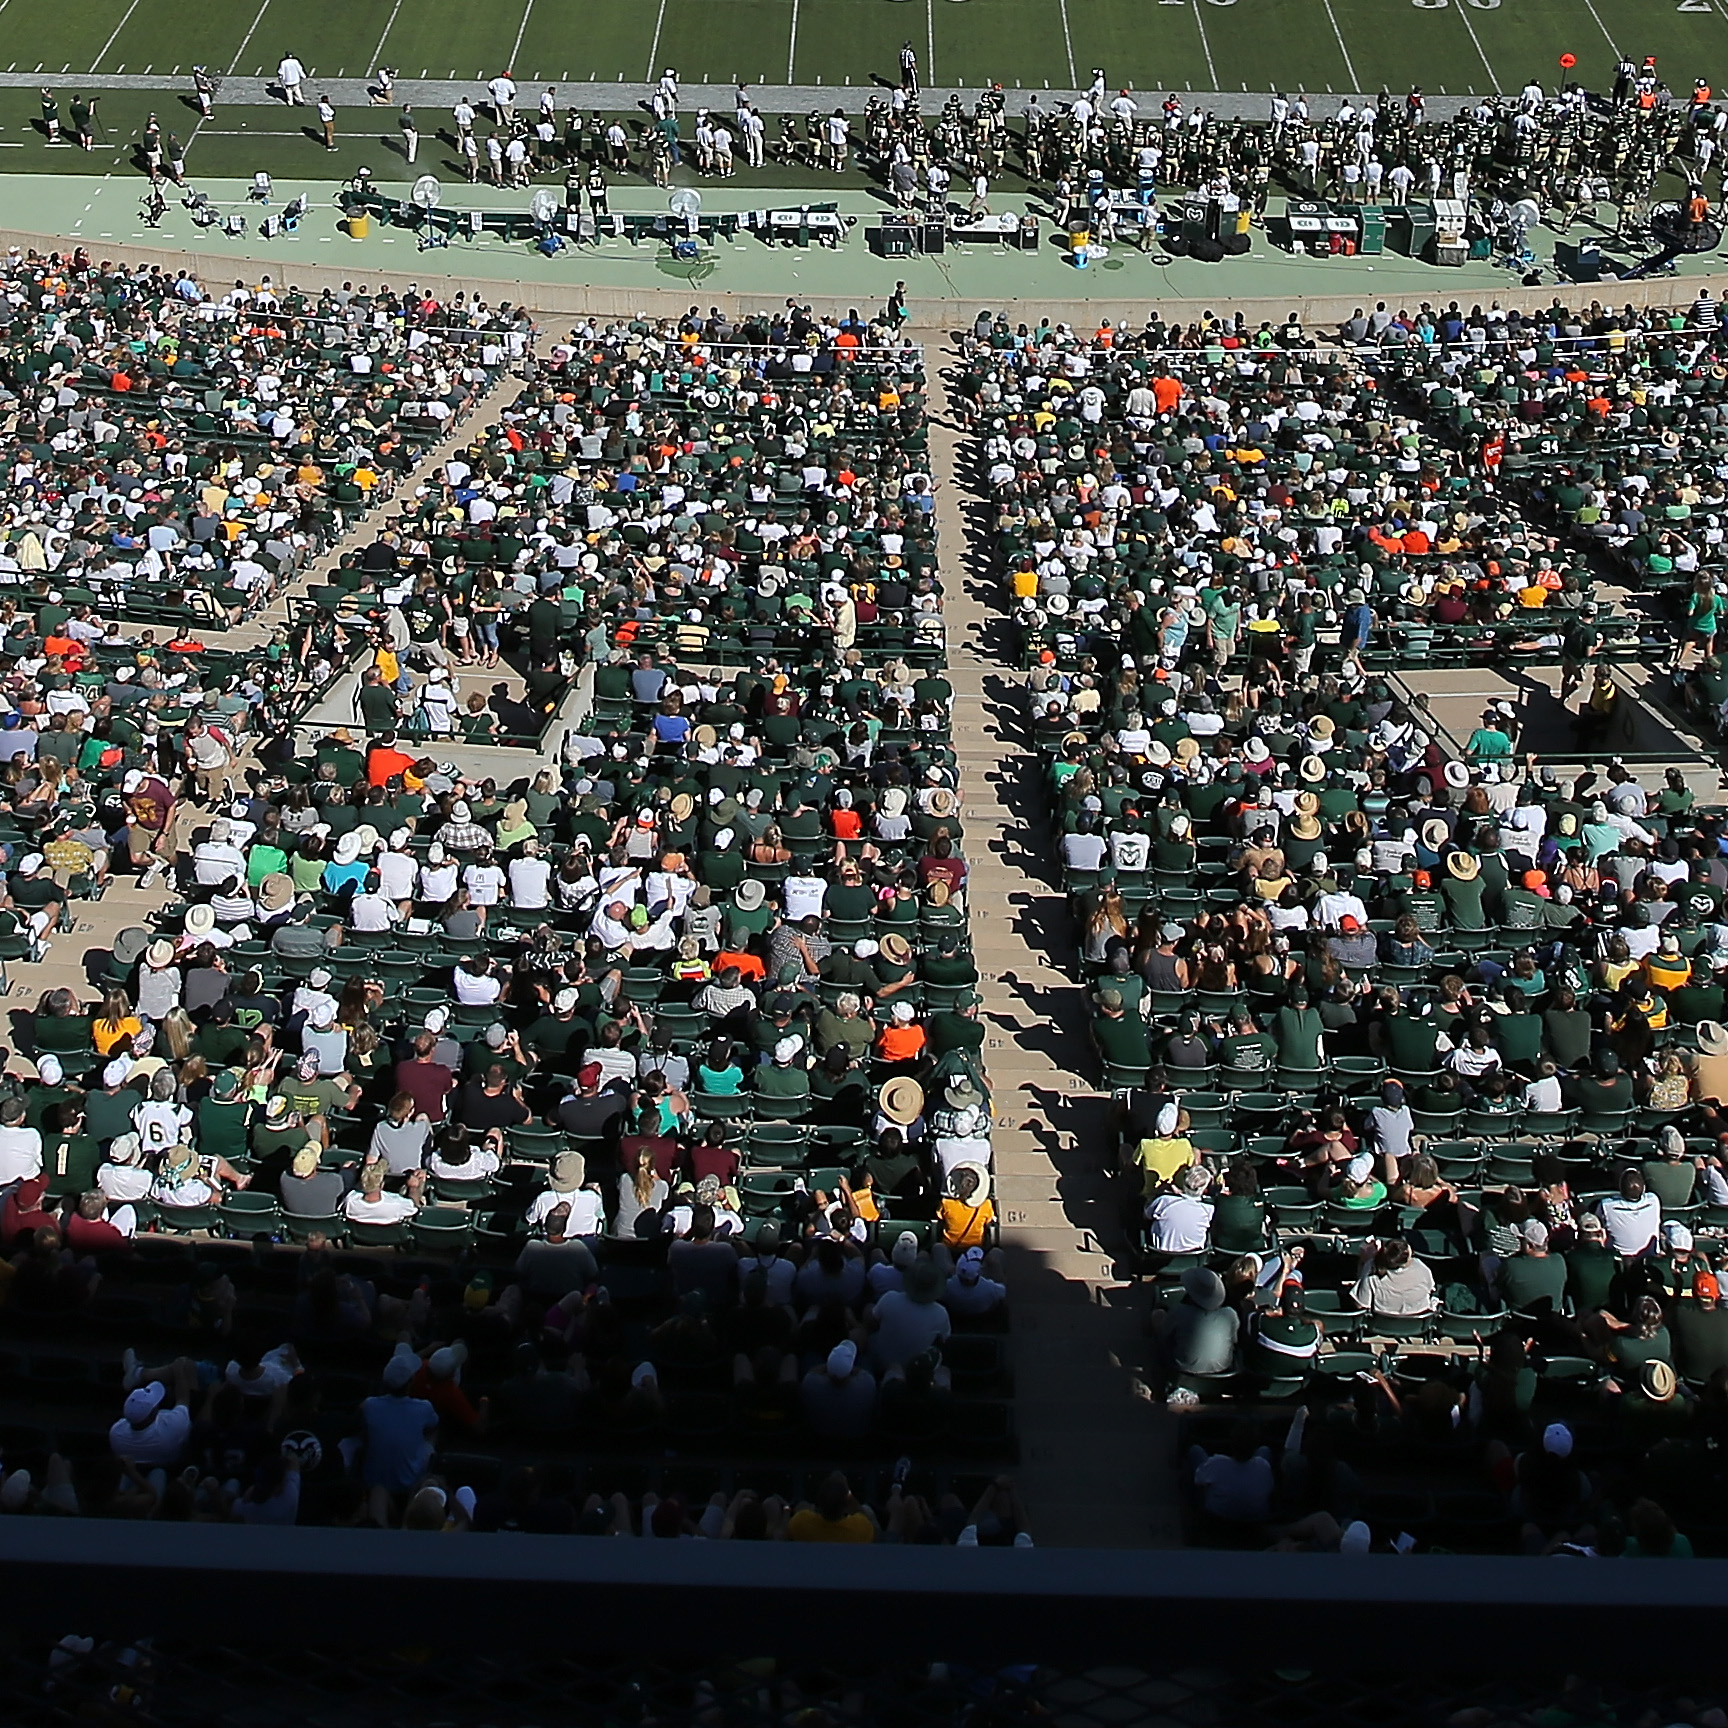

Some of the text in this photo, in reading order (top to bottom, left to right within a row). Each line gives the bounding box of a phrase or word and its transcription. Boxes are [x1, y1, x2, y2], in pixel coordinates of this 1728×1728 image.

[1539, 439, 1559, 455] 94
[235, 1007, 263, 1028] 12
[149, 1121, 163, 1142] 6
[56, 1143, 69, 1175] 1
